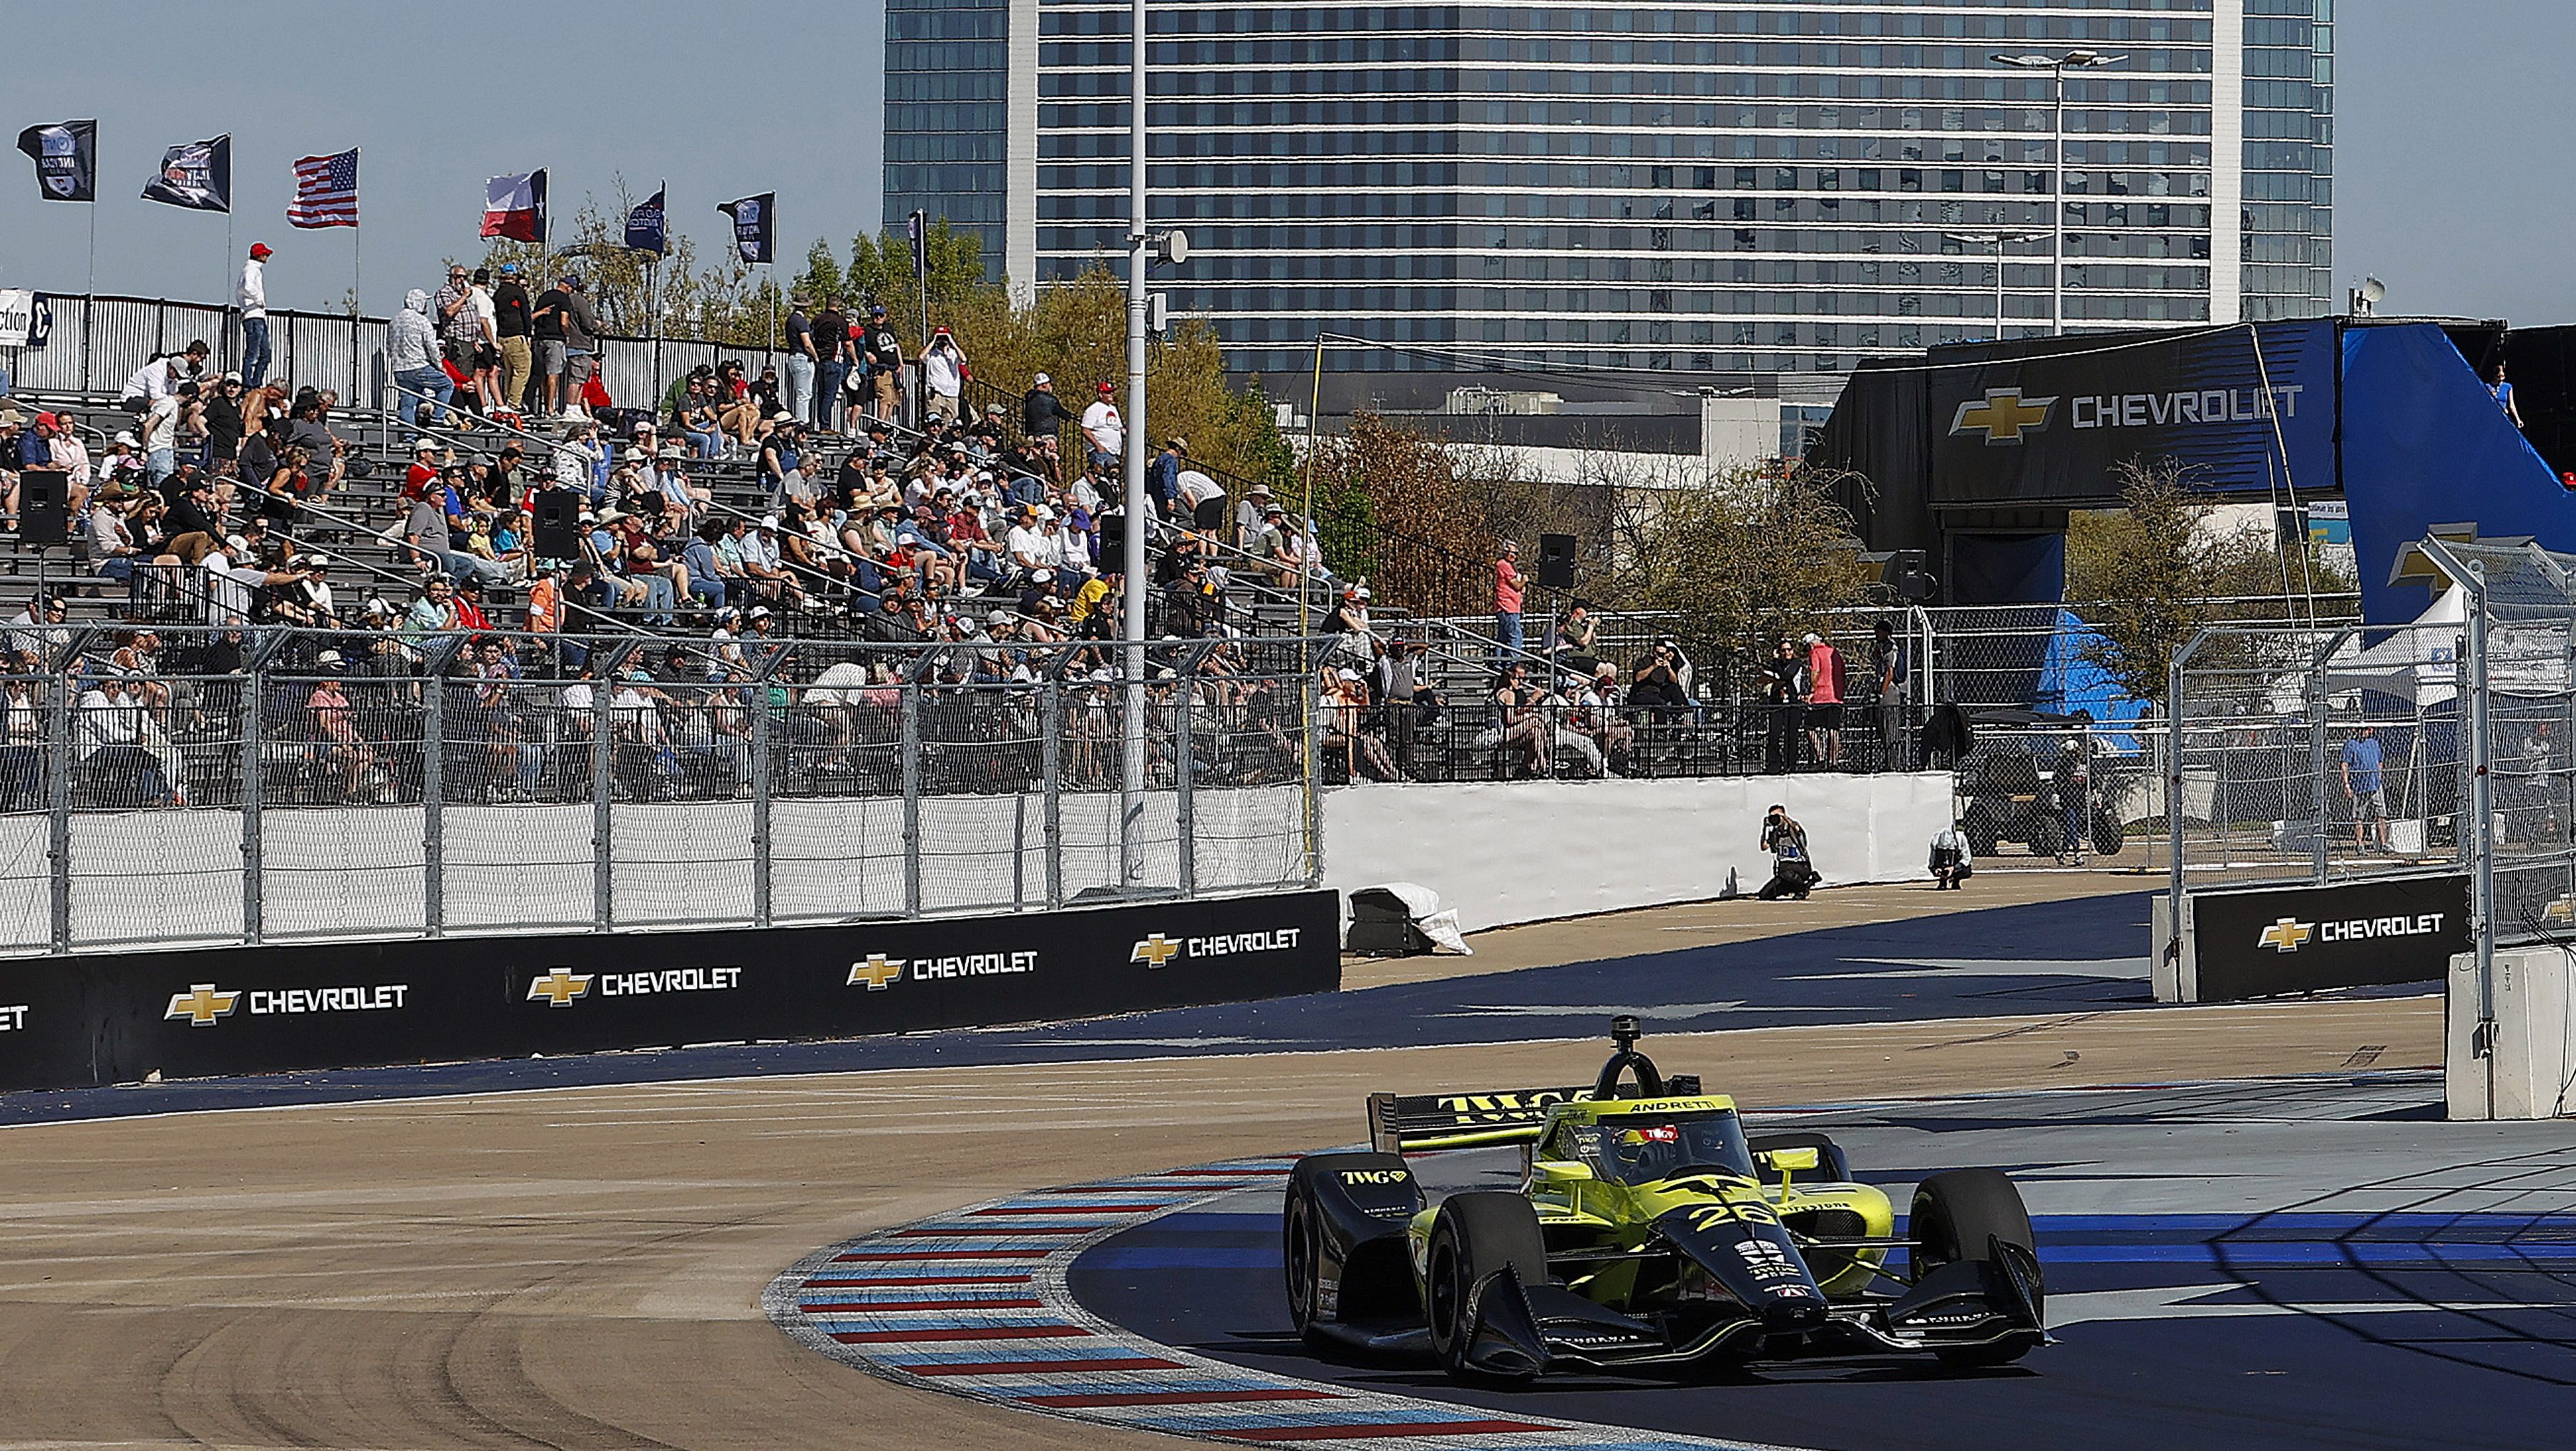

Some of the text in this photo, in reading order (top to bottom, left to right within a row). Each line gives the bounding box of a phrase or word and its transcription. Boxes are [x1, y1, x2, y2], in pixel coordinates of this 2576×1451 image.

[2072, 385, 2303, 429] CHEVROLET
[2321, 912, 2444, 942] CHEVROLET
[1188, 928, 1301, 958] CHEVROLET
[913, 950, 1038, 980] CHEVROLET
[601, 967, 742, 996] CHEVROLET
[250, 985, 409, 1015] CHEVROLET
[1629, 1100, 1717, 1113] ANDRETTI
[1341, 1171, 1390, 1185] TWG
[1688, 1205, 1777, 1232] 26
